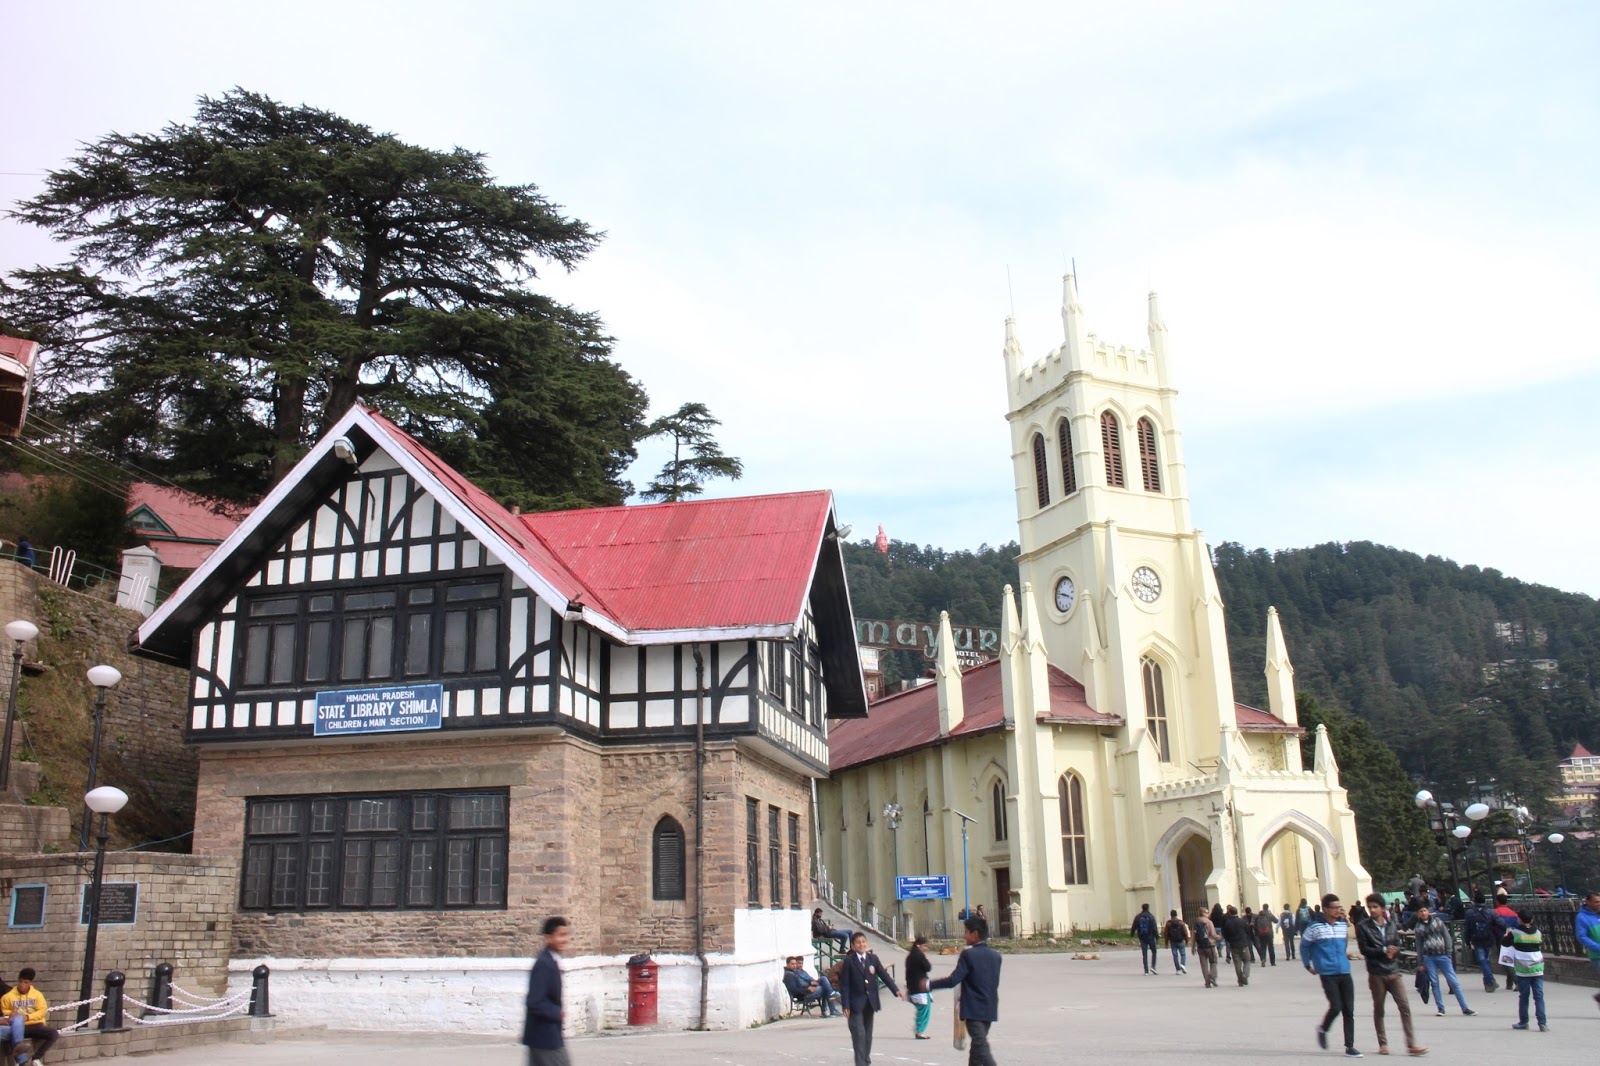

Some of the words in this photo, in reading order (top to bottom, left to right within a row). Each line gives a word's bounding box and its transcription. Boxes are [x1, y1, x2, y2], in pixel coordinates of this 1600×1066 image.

[346, 692, 380, 702] HIMACHAL
[382, 690, 415, 700] PRADESH
[318, 704, 346, 719] STATE
[350, 701, 394, 717] LIBRARY
[399, 698, 438, 714] SHIMLA
[362, 720, 368, 728] &
[369, 717, 386, 727] MAIN
